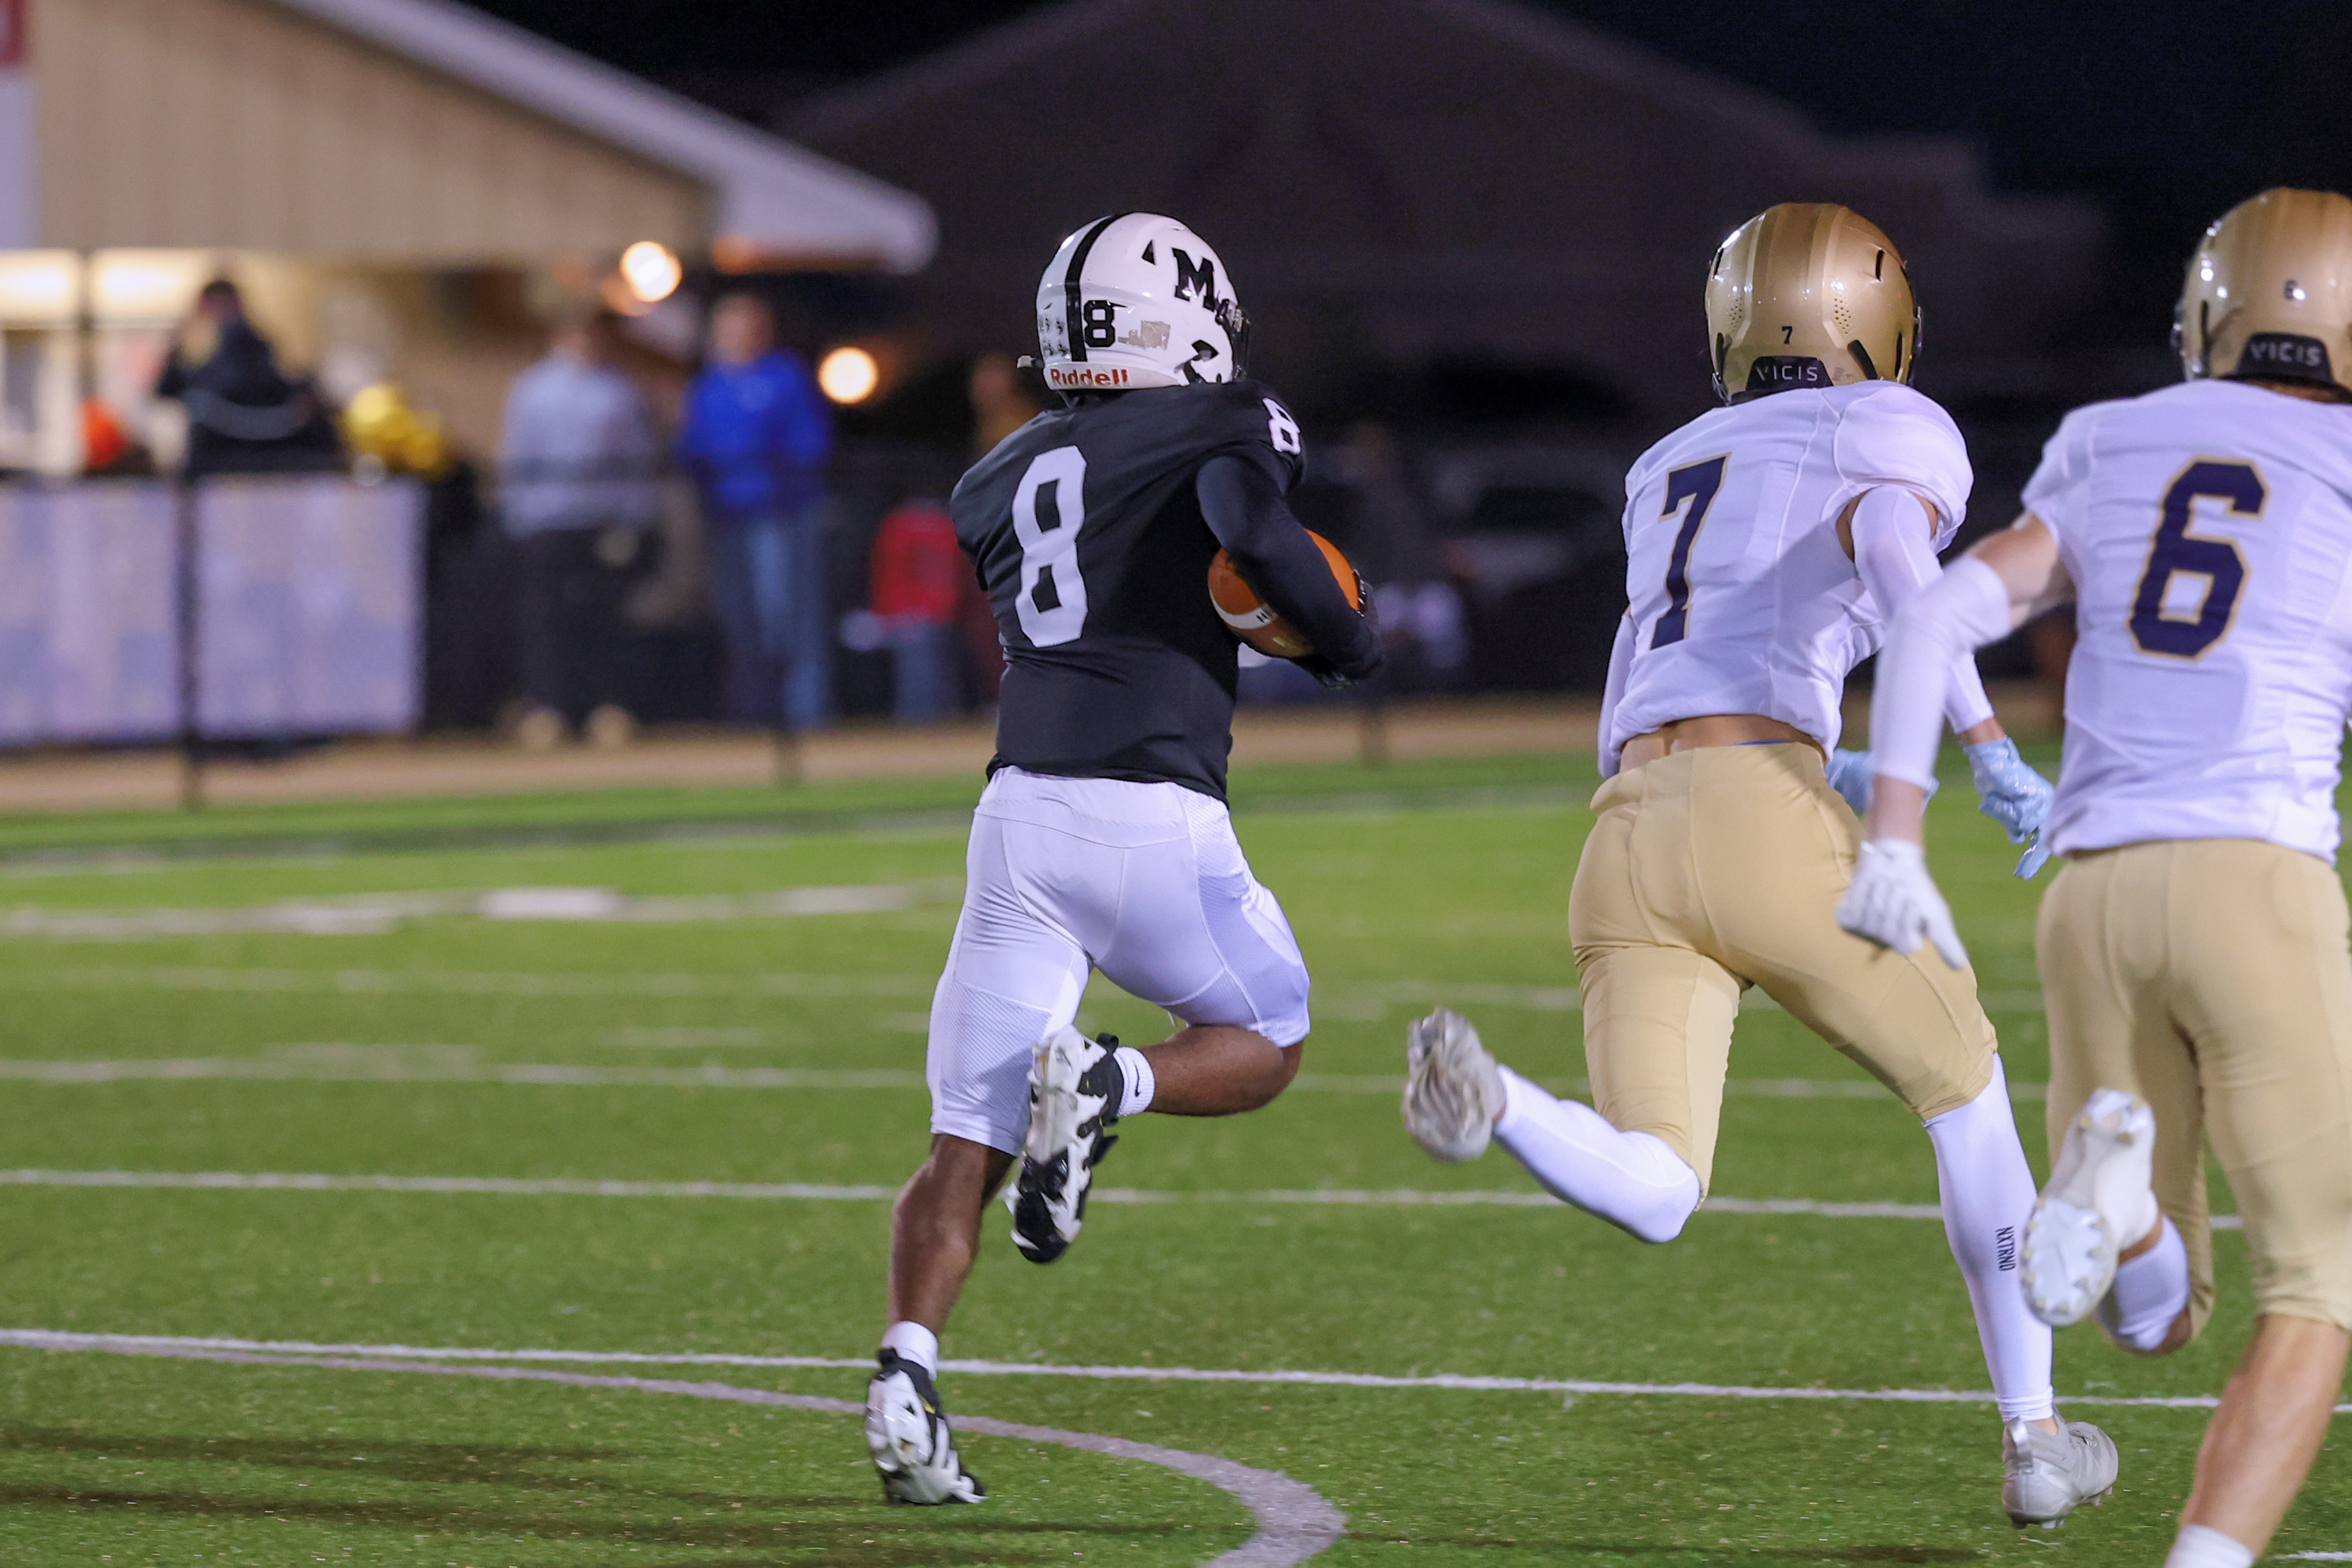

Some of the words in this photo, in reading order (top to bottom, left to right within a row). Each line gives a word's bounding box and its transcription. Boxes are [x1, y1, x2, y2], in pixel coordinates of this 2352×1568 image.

[1172, 247, 1214, 313] M
[1084, 300, 1115, 347] 8
[1781, 326, 1793, 344] 7
[1050, 368, 1129, 386] Riddell
[1756, 365, 1818, 381] VICIS
[2250, 342, 2321, 367] VICIS
[1262, 397, 1301, 455] 8
[1012, 445, 1088, 648] 8
[1649, 452, 1732, 651] 7
[2125, 453, 2271, 663] 6
[1994, 1225, 2017, 1272] NXTRND
